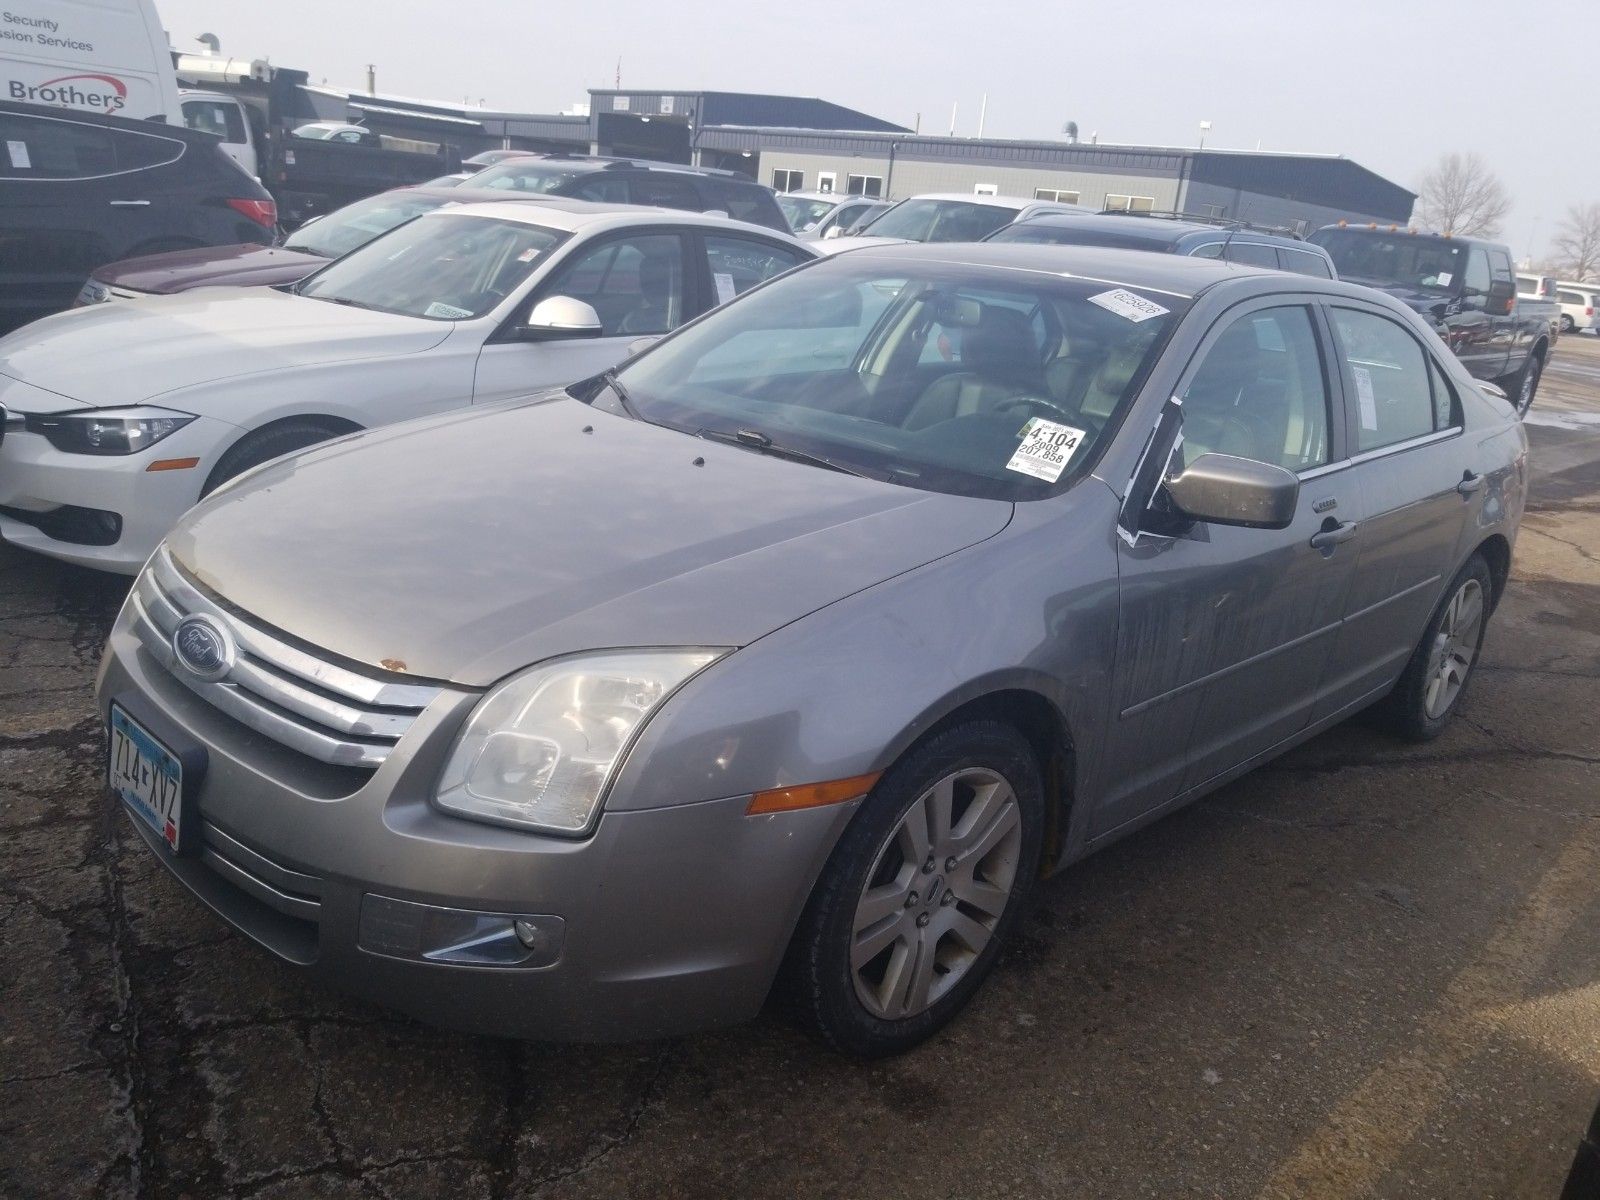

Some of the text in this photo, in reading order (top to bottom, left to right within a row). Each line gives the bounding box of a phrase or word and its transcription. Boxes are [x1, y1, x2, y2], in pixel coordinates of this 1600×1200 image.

[3, 12, 58, 32] Security
[37, 33, 93, 51] Services
[9, 80, 125, 109] Brothers
[1032, 440, 1060, 453] 2009
[183, 628, 212, 661] Ford
